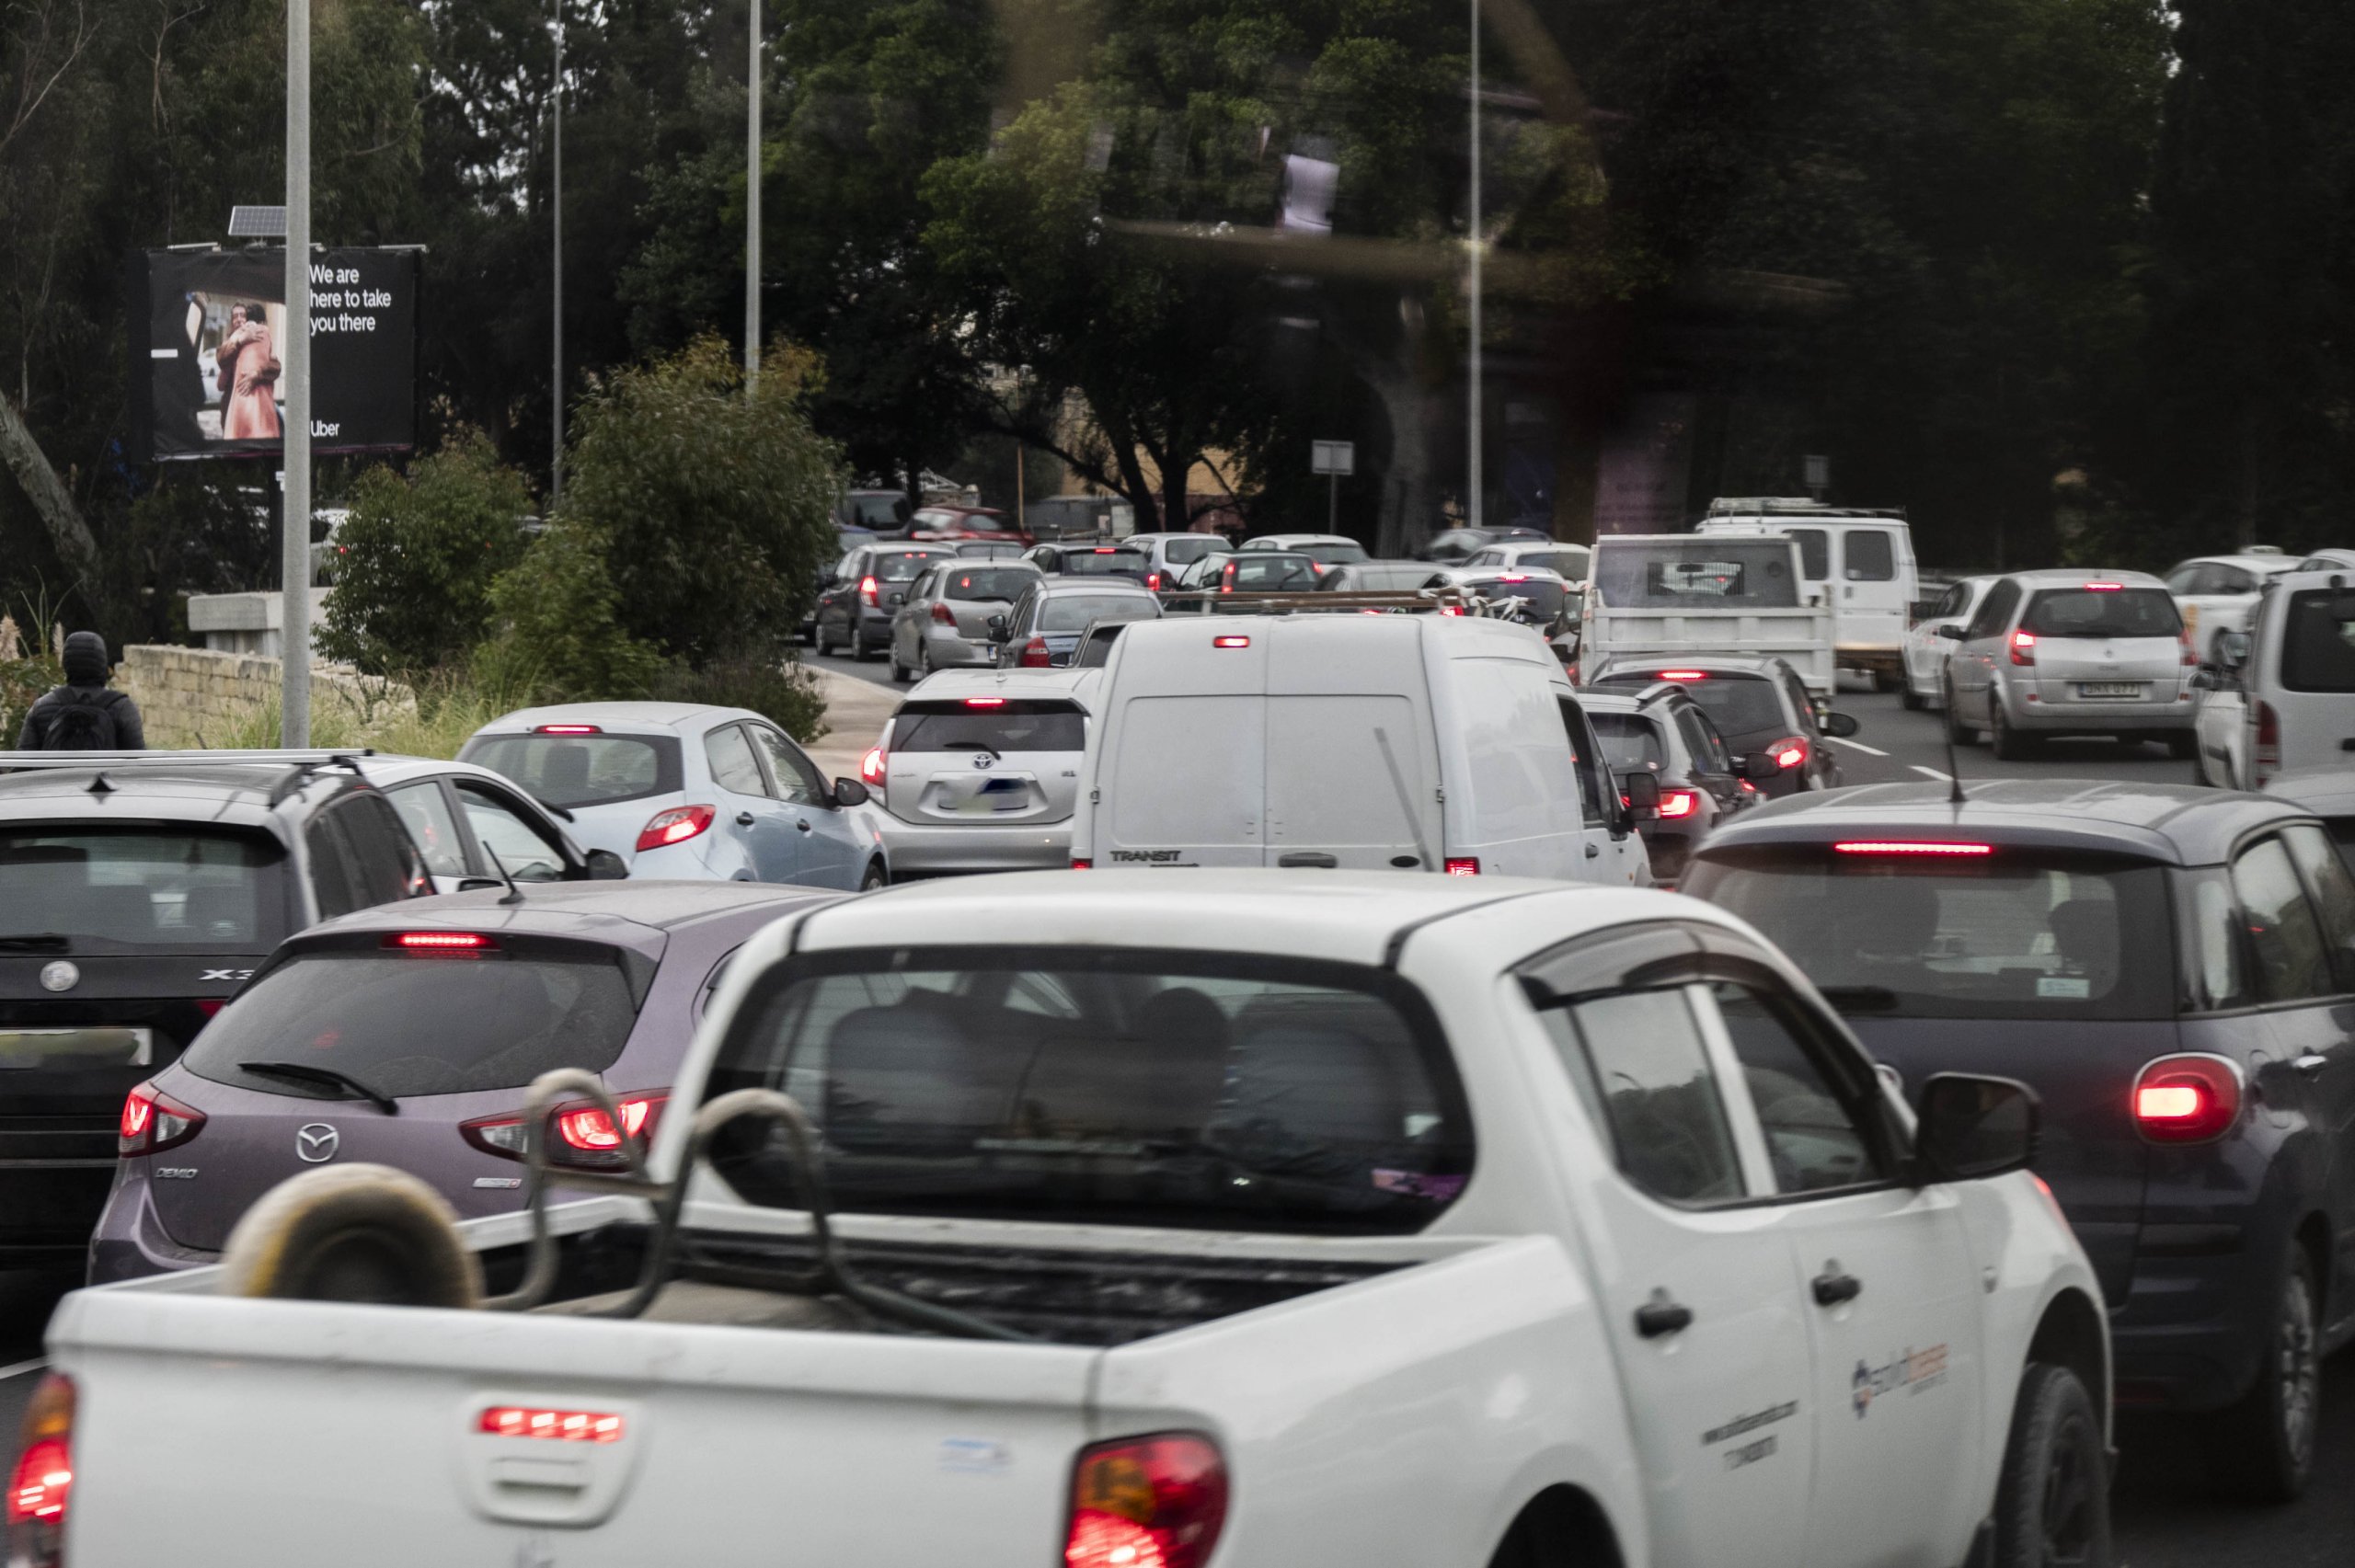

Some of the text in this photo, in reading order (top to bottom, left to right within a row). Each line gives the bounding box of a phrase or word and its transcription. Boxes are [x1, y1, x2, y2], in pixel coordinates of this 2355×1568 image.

[309, 264, 360, 284] We are
[310, 288, 392, 308] here to take
[310, 313, 376, 337] you there
[310, 419, 340, 438] Uber
[1109, 850, 1181, 862] TRANSIT
[155, 1167, 199, 1179] DEMIO
